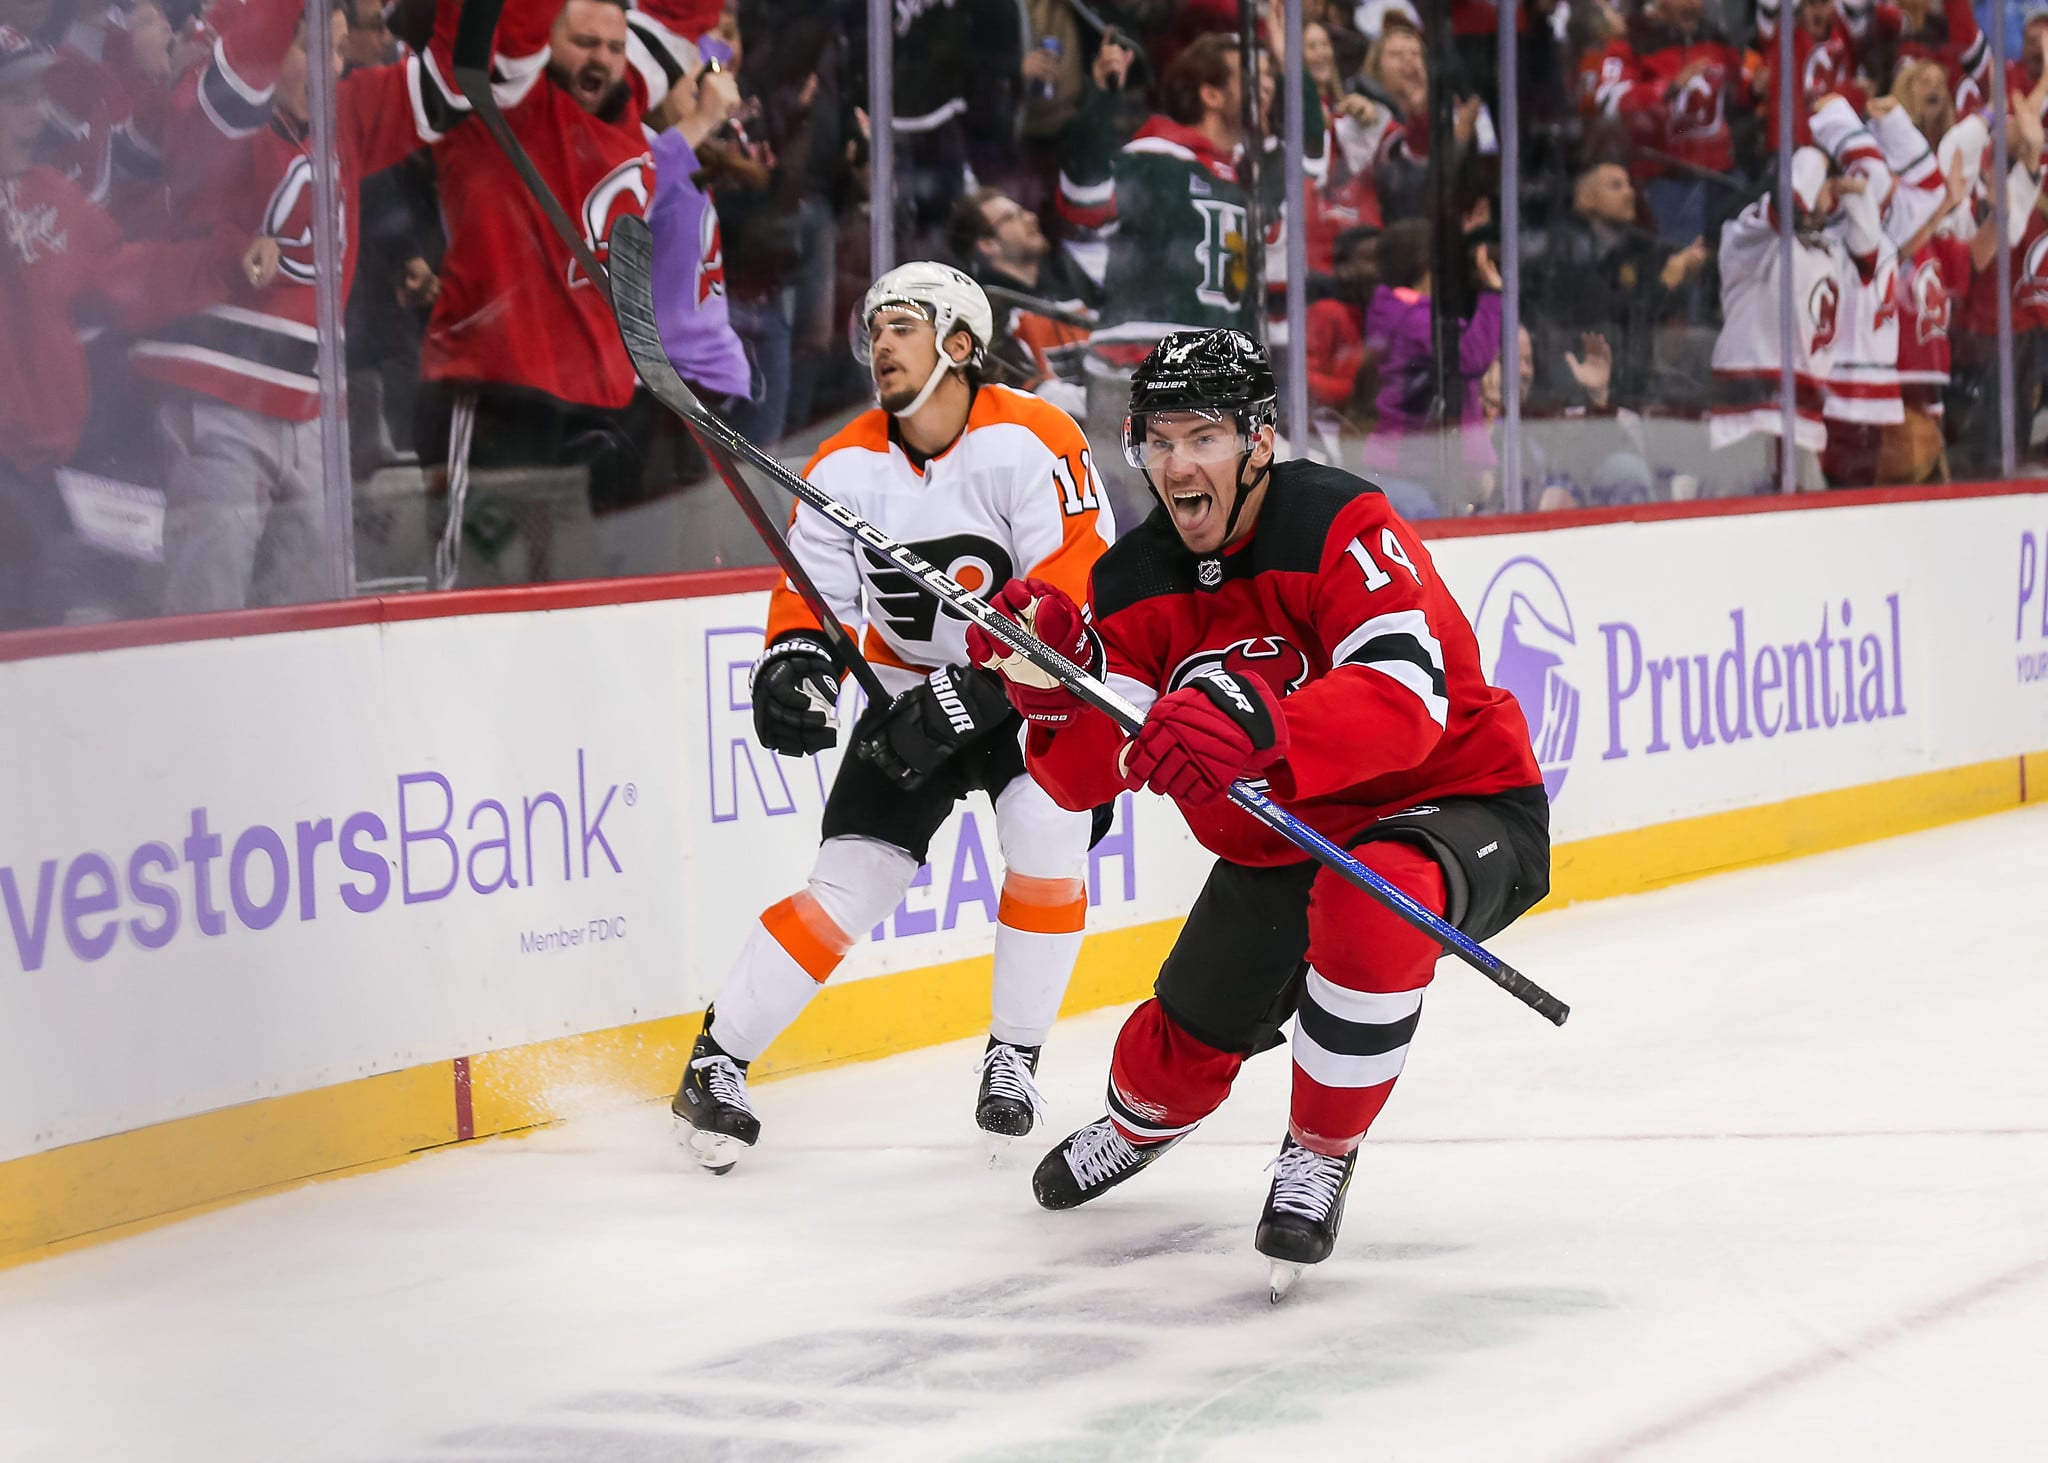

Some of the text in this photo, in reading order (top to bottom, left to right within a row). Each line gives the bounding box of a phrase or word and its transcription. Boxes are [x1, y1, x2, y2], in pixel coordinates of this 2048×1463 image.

[1146, 380, 1188, 390] BAUER
[1052, 448, 1101, 517] 11
[822, 501, 997, 621] BAUER
[1344, 527, 1424, 593] 14
[1598, 590, 1908, 761] Prudential
[1028, 712, 1068, 722] BAUER
[519, 915, 626, 954] Member FDIC
